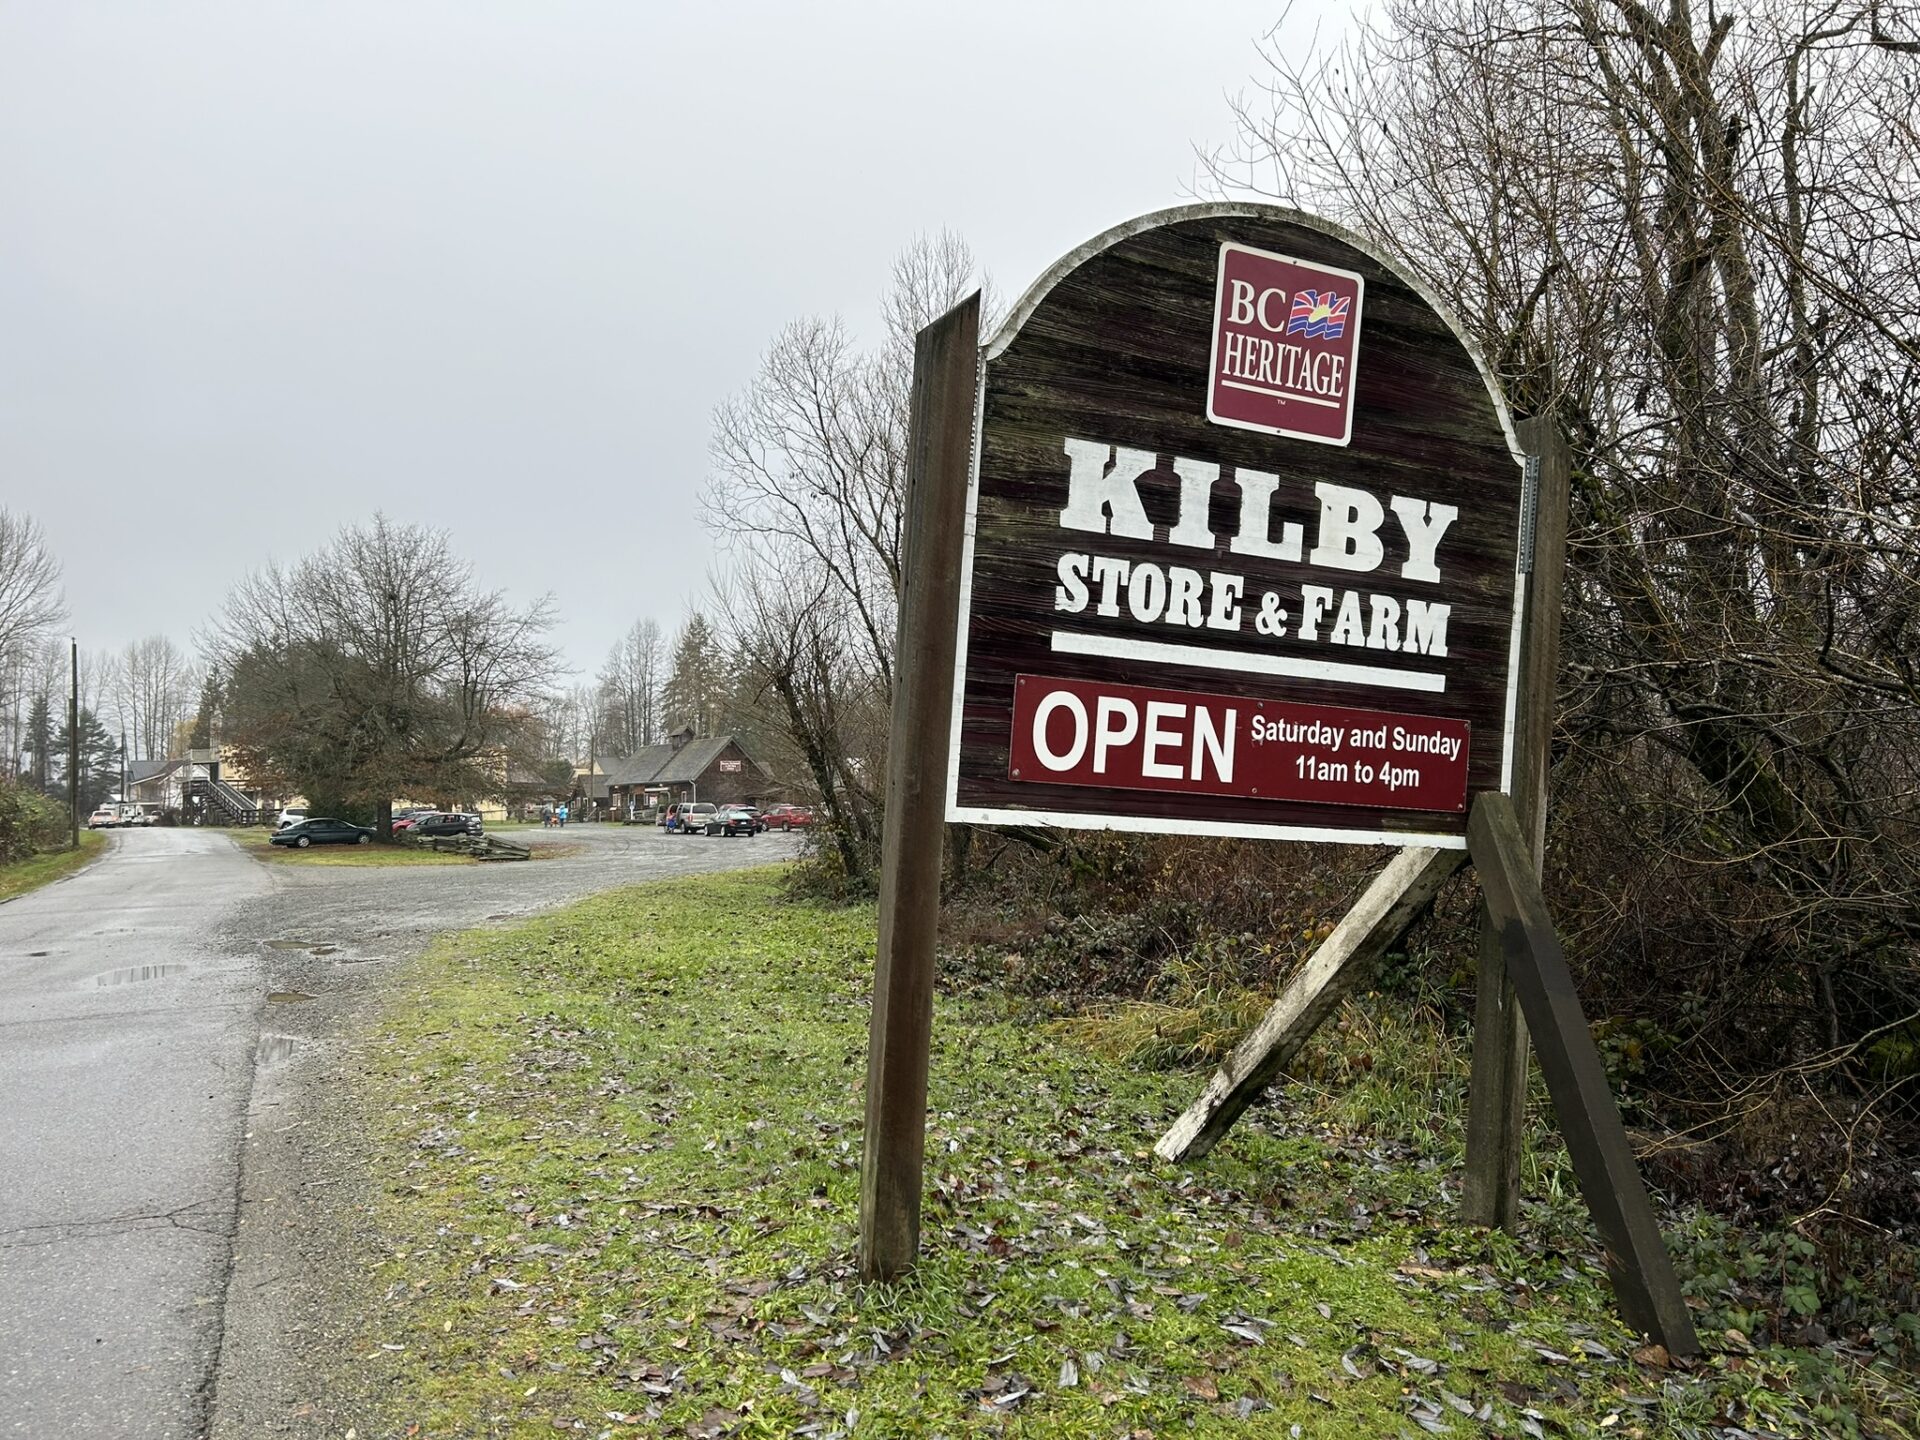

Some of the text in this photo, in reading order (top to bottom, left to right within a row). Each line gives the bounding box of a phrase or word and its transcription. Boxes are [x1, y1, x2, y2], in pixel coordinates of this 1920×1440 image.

[1227, 279, 1286, 332] BC
[1221, 331, 1345, 397] HERITAGE
[1059, 437, 1458, 584] KILBY
[1055, 553, 1451, 657] STORE & FARM
[1032, 690, 1237, 783] OPEN
[1251, 715, 1462, 761] Saturday and Sunday
[1295, 755, 1420, 791] 11am to 4pm
